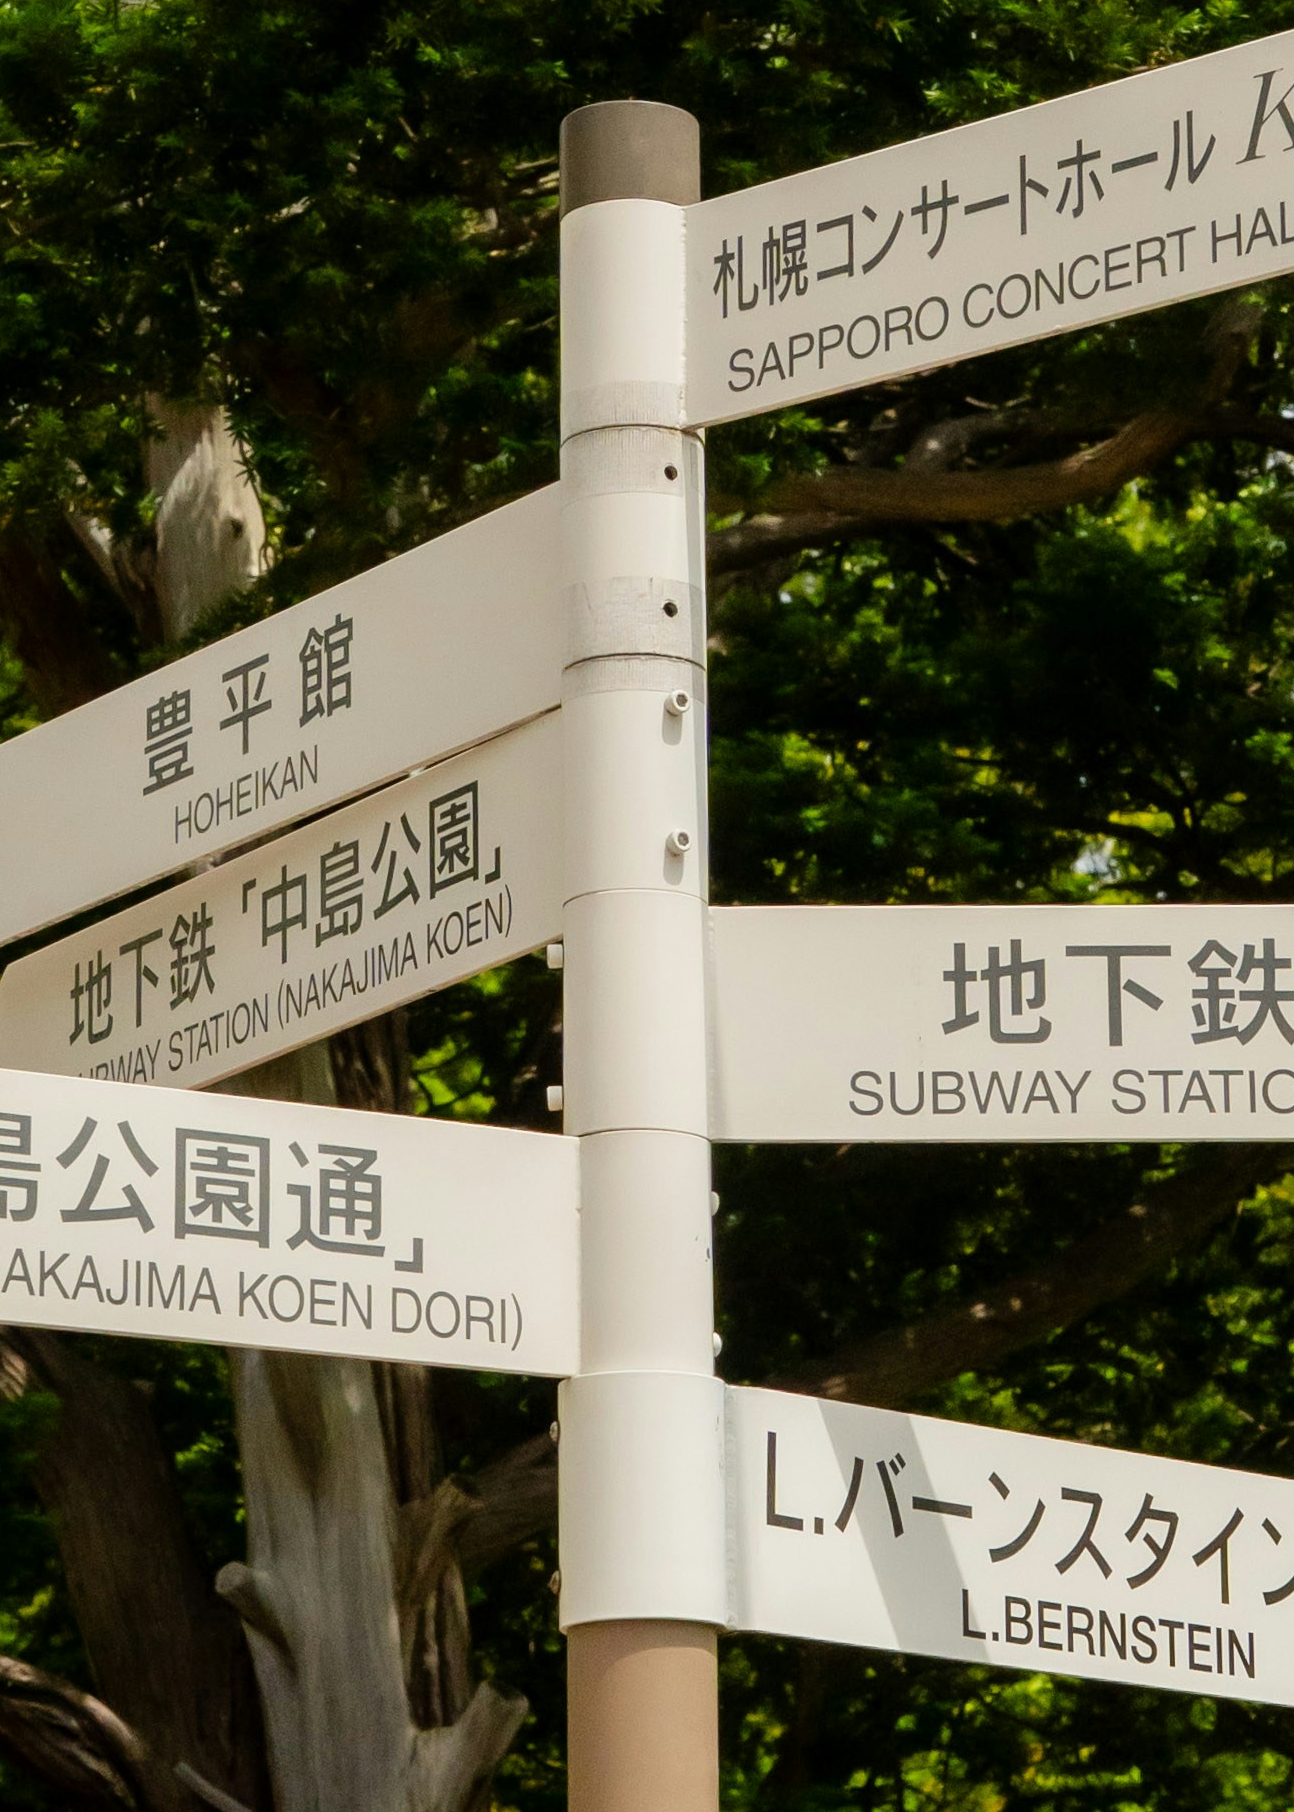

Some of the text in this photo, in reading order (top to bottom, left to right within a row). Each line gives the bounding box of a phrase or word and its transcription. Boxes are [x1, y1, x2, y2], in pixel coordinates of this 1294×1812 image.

[713, 110, 1216, 318] 札幌コンサートホール
[728, 296, 949, 392] SAPPORO
[963, 226, 1196, 328] CONCERT
[143, 613, 353, 796] 豊平館
[175, 745, 317, 843] HOHEIKAN
[169, 994, 268, 1071] STATION
[278, 932, 418, 1029] (NAKAJIMA
[427, 884, 512, 964] KOEN)
[849, 1070, 1091, 1115] SUBWAY
[239, 1272, 372, 1329] KOEN
[392, 1288, 522, 1351] DORI)
[962, 1589, 1255, 1678] L.BERNSTEIN
